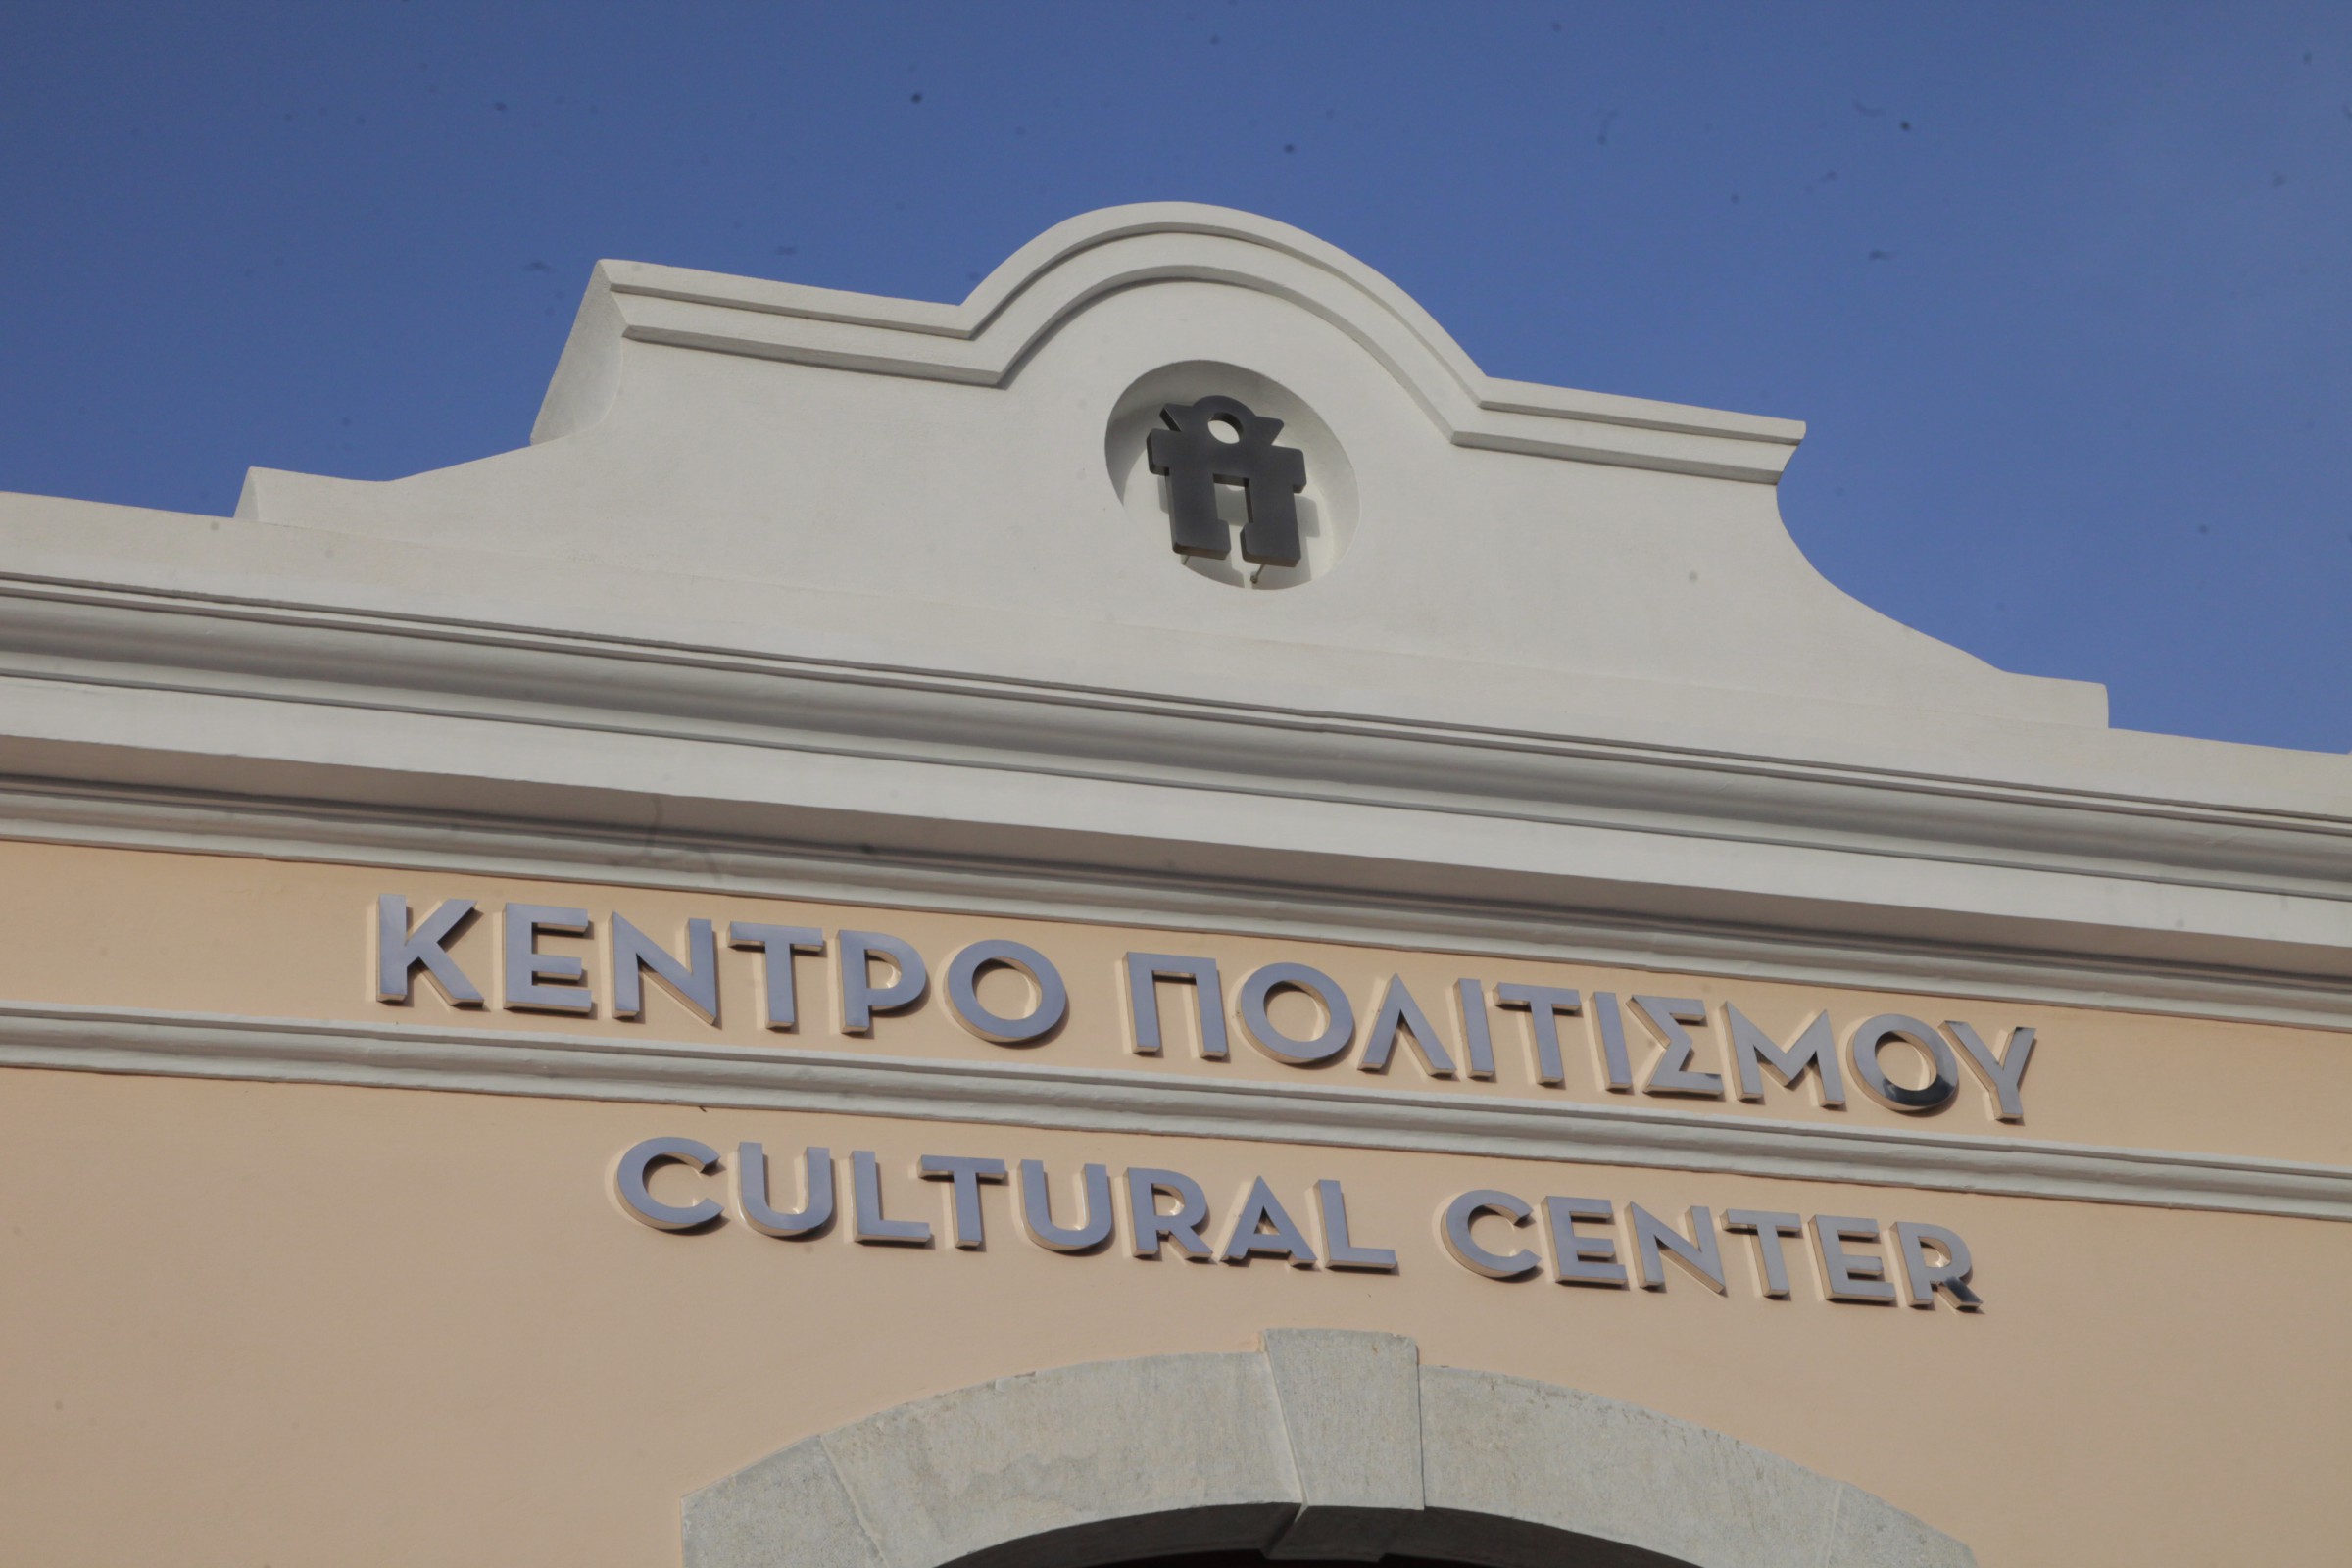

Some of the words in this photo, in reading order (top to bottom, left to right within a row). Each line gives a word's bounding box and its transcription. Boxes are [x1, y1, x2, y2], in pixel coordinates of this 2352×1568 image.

[376, 893, 1068, 1044] ΚΕΝΤΡΟ
[1124, 951, 2036, 1121] ΠΟΛΙΤΙΣΜΟΥ
[616, 1136, 1397, 1272] CULTURAL
[1441, 1189, 1984, 1312] CENTER
